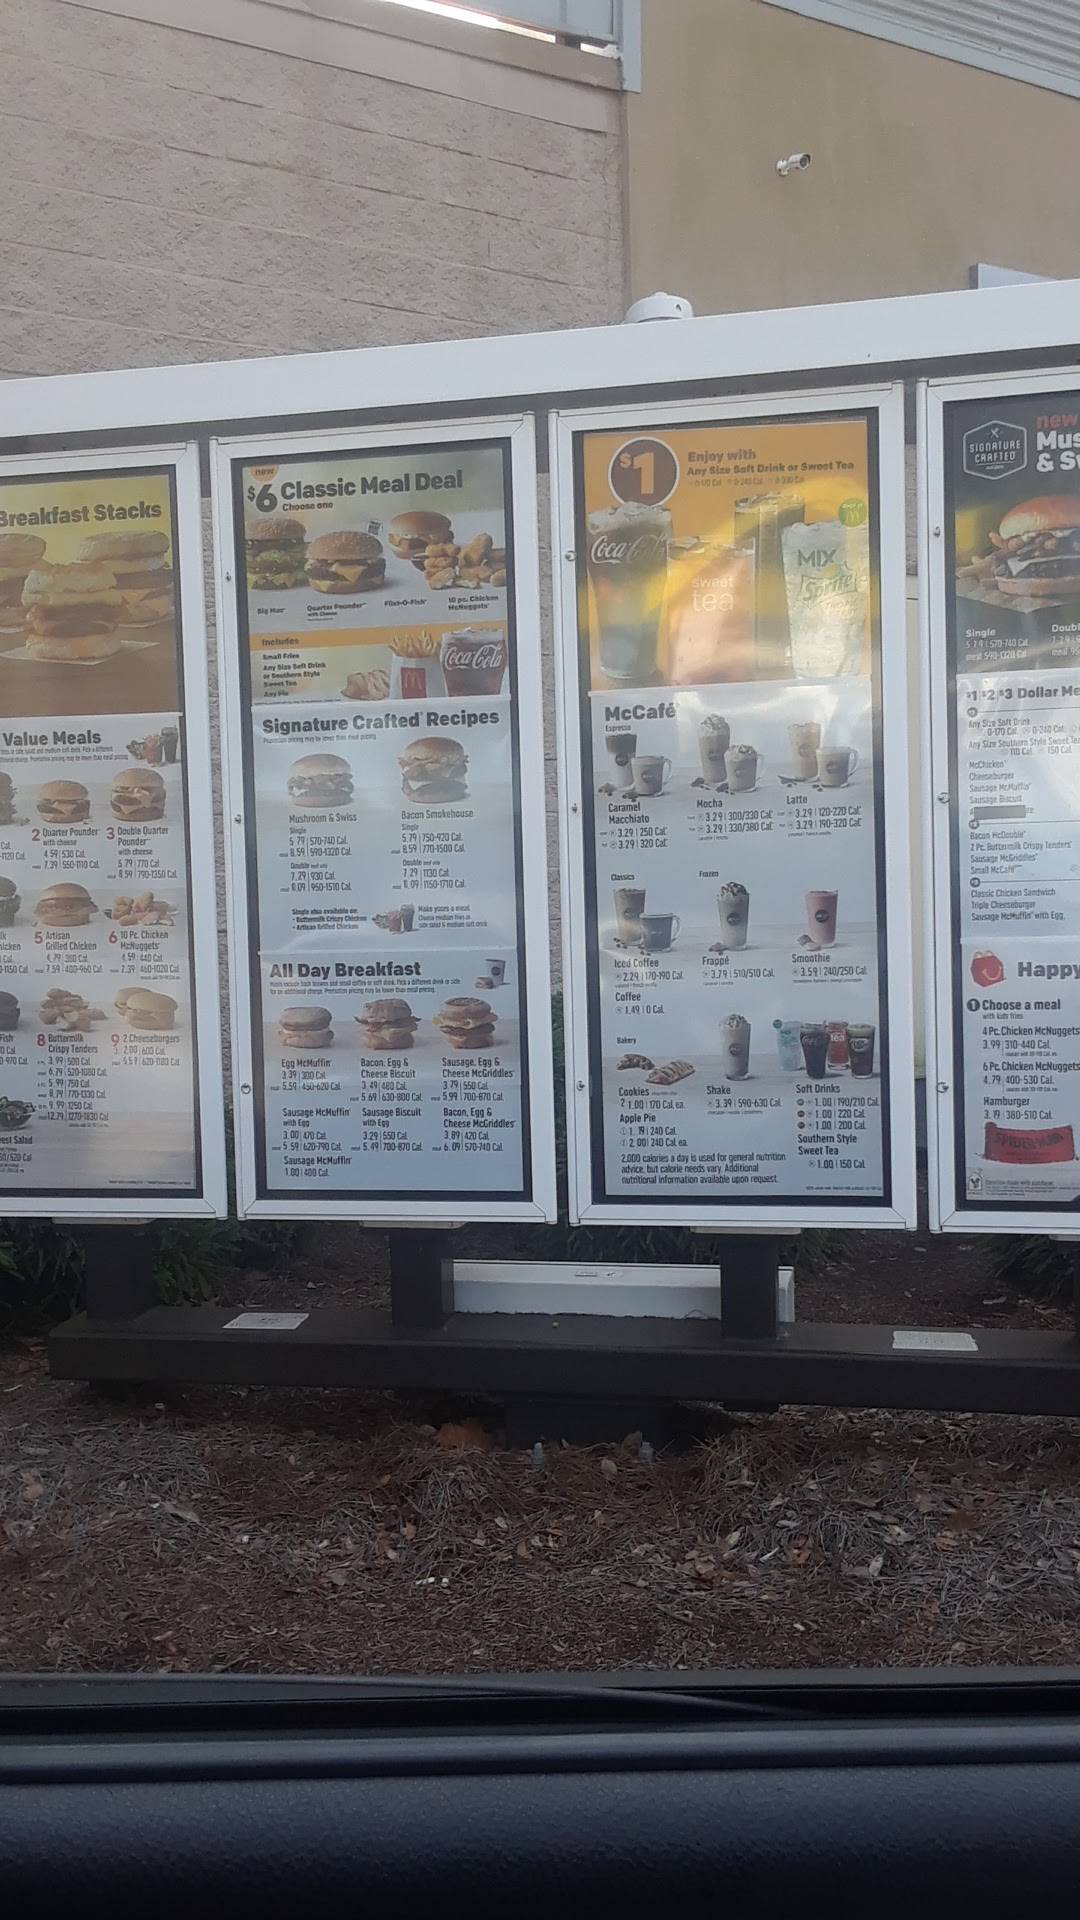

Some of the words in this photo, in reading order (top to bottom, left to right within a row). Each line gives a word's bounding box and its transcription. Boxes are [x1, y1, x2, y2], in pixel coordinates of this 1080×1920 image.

[1037, 415, 1078, 428] new
[970, 440, 1020, 452] SIGNATURE
[688, 451, 723, 464] Enjoy
[727, 450, 756, 461] with
[975, 451, 1015, 463] CRAFTED
[688, 466, 706, 476] Any
[709, 466, 731, 475] Size
[734, 465, 754, 474] Soft
[758, 464, 785, 473] Drink
[801, 462, 833, 471] Sweet
[836, 461, 854, 470] Tea
[248, 484, 278, 512] $6
[281, 478, 355, 500] Classic
[361, 474, 409, 495] Meal
[415, 470, 463, 490] Deal
[94, 501, 161, 521] Stacks
[283, 503, 315, 512] Choose
[317, 502, 333, 510] one
[799, 551, 836, 568] MIX
[693, 577, 734, 588] sweet
[693, 589, 734, 612] tea
[262, 637, 299, 646] Includes
[605, 703, 676, 721] McCafé
[263, 718, 348, 735] Signature
[353, 713, 420, 730] Crafted
[427, 710, 499, 728] Recipes
[3, 732, 48, 746] Value
[53, 730, 101, 744] Meals
[697, 799, 723, 808] Mocha
[787, 795, 807, 804] Latte
[608, 802, 640, 813] Caramel
[289, 815, 326, 823] Mushroom
[336, 814, 357, 822] Swiss
[402, 811, 424, 820] Bacon
[426, 809, 473, 819] Smokehouse
[609, 814, 649, 824] Macchiato
[43, 828, 68, 837] Quarter
[69, 828, 98, 836] Pounder
[118, 827, 141, 835] Double
[143, 827, 168, 835] Quarter
[118, 838, 146, 846] Pounder
[611, 873, 635, 881] Classics
[700, 870, 719, 878] Frozen
[971, 890, 994, 898] Classic
[996, 889, 1022, 897] Chicken
[1024, 888, 1055, 897] Sandwich
[972, 901, 988, 909] Triple
[46, 932, 70, 940] Artisan
[70, 942, 96, 950] Chicken
[121, 942, 159, 951] McNuggets
[614, 959, 631, 968] Iced
[633, 958, 659, 967] Coffee
[702, 956, 730, 967] Frappé
[792, 953, 830, 963] Smoothie
[270, 963, 292, 978] All
[297, 963, 330, 980] Day
[335, 961, 421, 977] Breakfast
[615, 992, 641, 1001] Coffee
[982, 1000, 1021, 1010] Choose
[1034, 999, 1061, 1010] meal
[1002, 1026, 1032, 1035] Chicken
[617, 1036, 636, 1045] Bakery
[49, 1046, 69, 1054] Crispy
[70, 1045, 98, 1053] Tenders
[297, 1059, 330, 1067] McMuffin
[478, 1058, 492, 1067] Egg
[1002, 1062, 1033, 1071] Chicken
[361, 1070, 387, 1078] Cheese
[390, 1069, 415, 1078] Biscuit
[443, 1069, 469, 1078] Cheese
[472, 1069, 512, 1078] McGriddles
[619, 1087, 649, 1097] Cookies
[706, 1086, 731, 1095] Shake
[796, 1084, 813, 1094] Soft
[815, 1083, 840, 1093] Drinks
[984, 1097, 1030, 1107] Hamburger
[283, 1108, 314, 1118] Sausage
[316, 1107, 349, 1117] McMuffin
[362, 1108, 393, 1118] Sausage
[396, 1107, 421, 1117] Biscuit
[471, 1107, 484, 1117] Egg
[444, 1119, 470, 1128] Cheese
[473, 1119, 513, 1128] McGriddles
[620, 1113, 646, 1124] Apple
[14, 1136, 32, 1144] Salad
[798, 1134, 832, 1144] Southern
[835, 1134, 857, 1144] Style
[798, 1146, 822, 1156] Sweet
[823, 1146, 839, 1155] Tea
[284, 1156, 315, 1166] Sausage
[317, 1156, 350, 1165] McMuffin
[643, 1153, 669, 1163] calories
[677, 1153, 689, 1164] day
[699, 1153, 715, 1162] used
[729, 1153, 754, 1164] general
[756, 1152, 786, 1161] nutrition
[660, 1163, 682, 1173] calorie
[685, 1163, 705, 1172] needs
[725, 1163, 758, 1173] Additional
[622, 1175, 656, 1185] nutritional
[658, 1175, 698, 1183] information
[700, 1175, 730, 1183] available
[732, 1176, 749, 1185] upon
